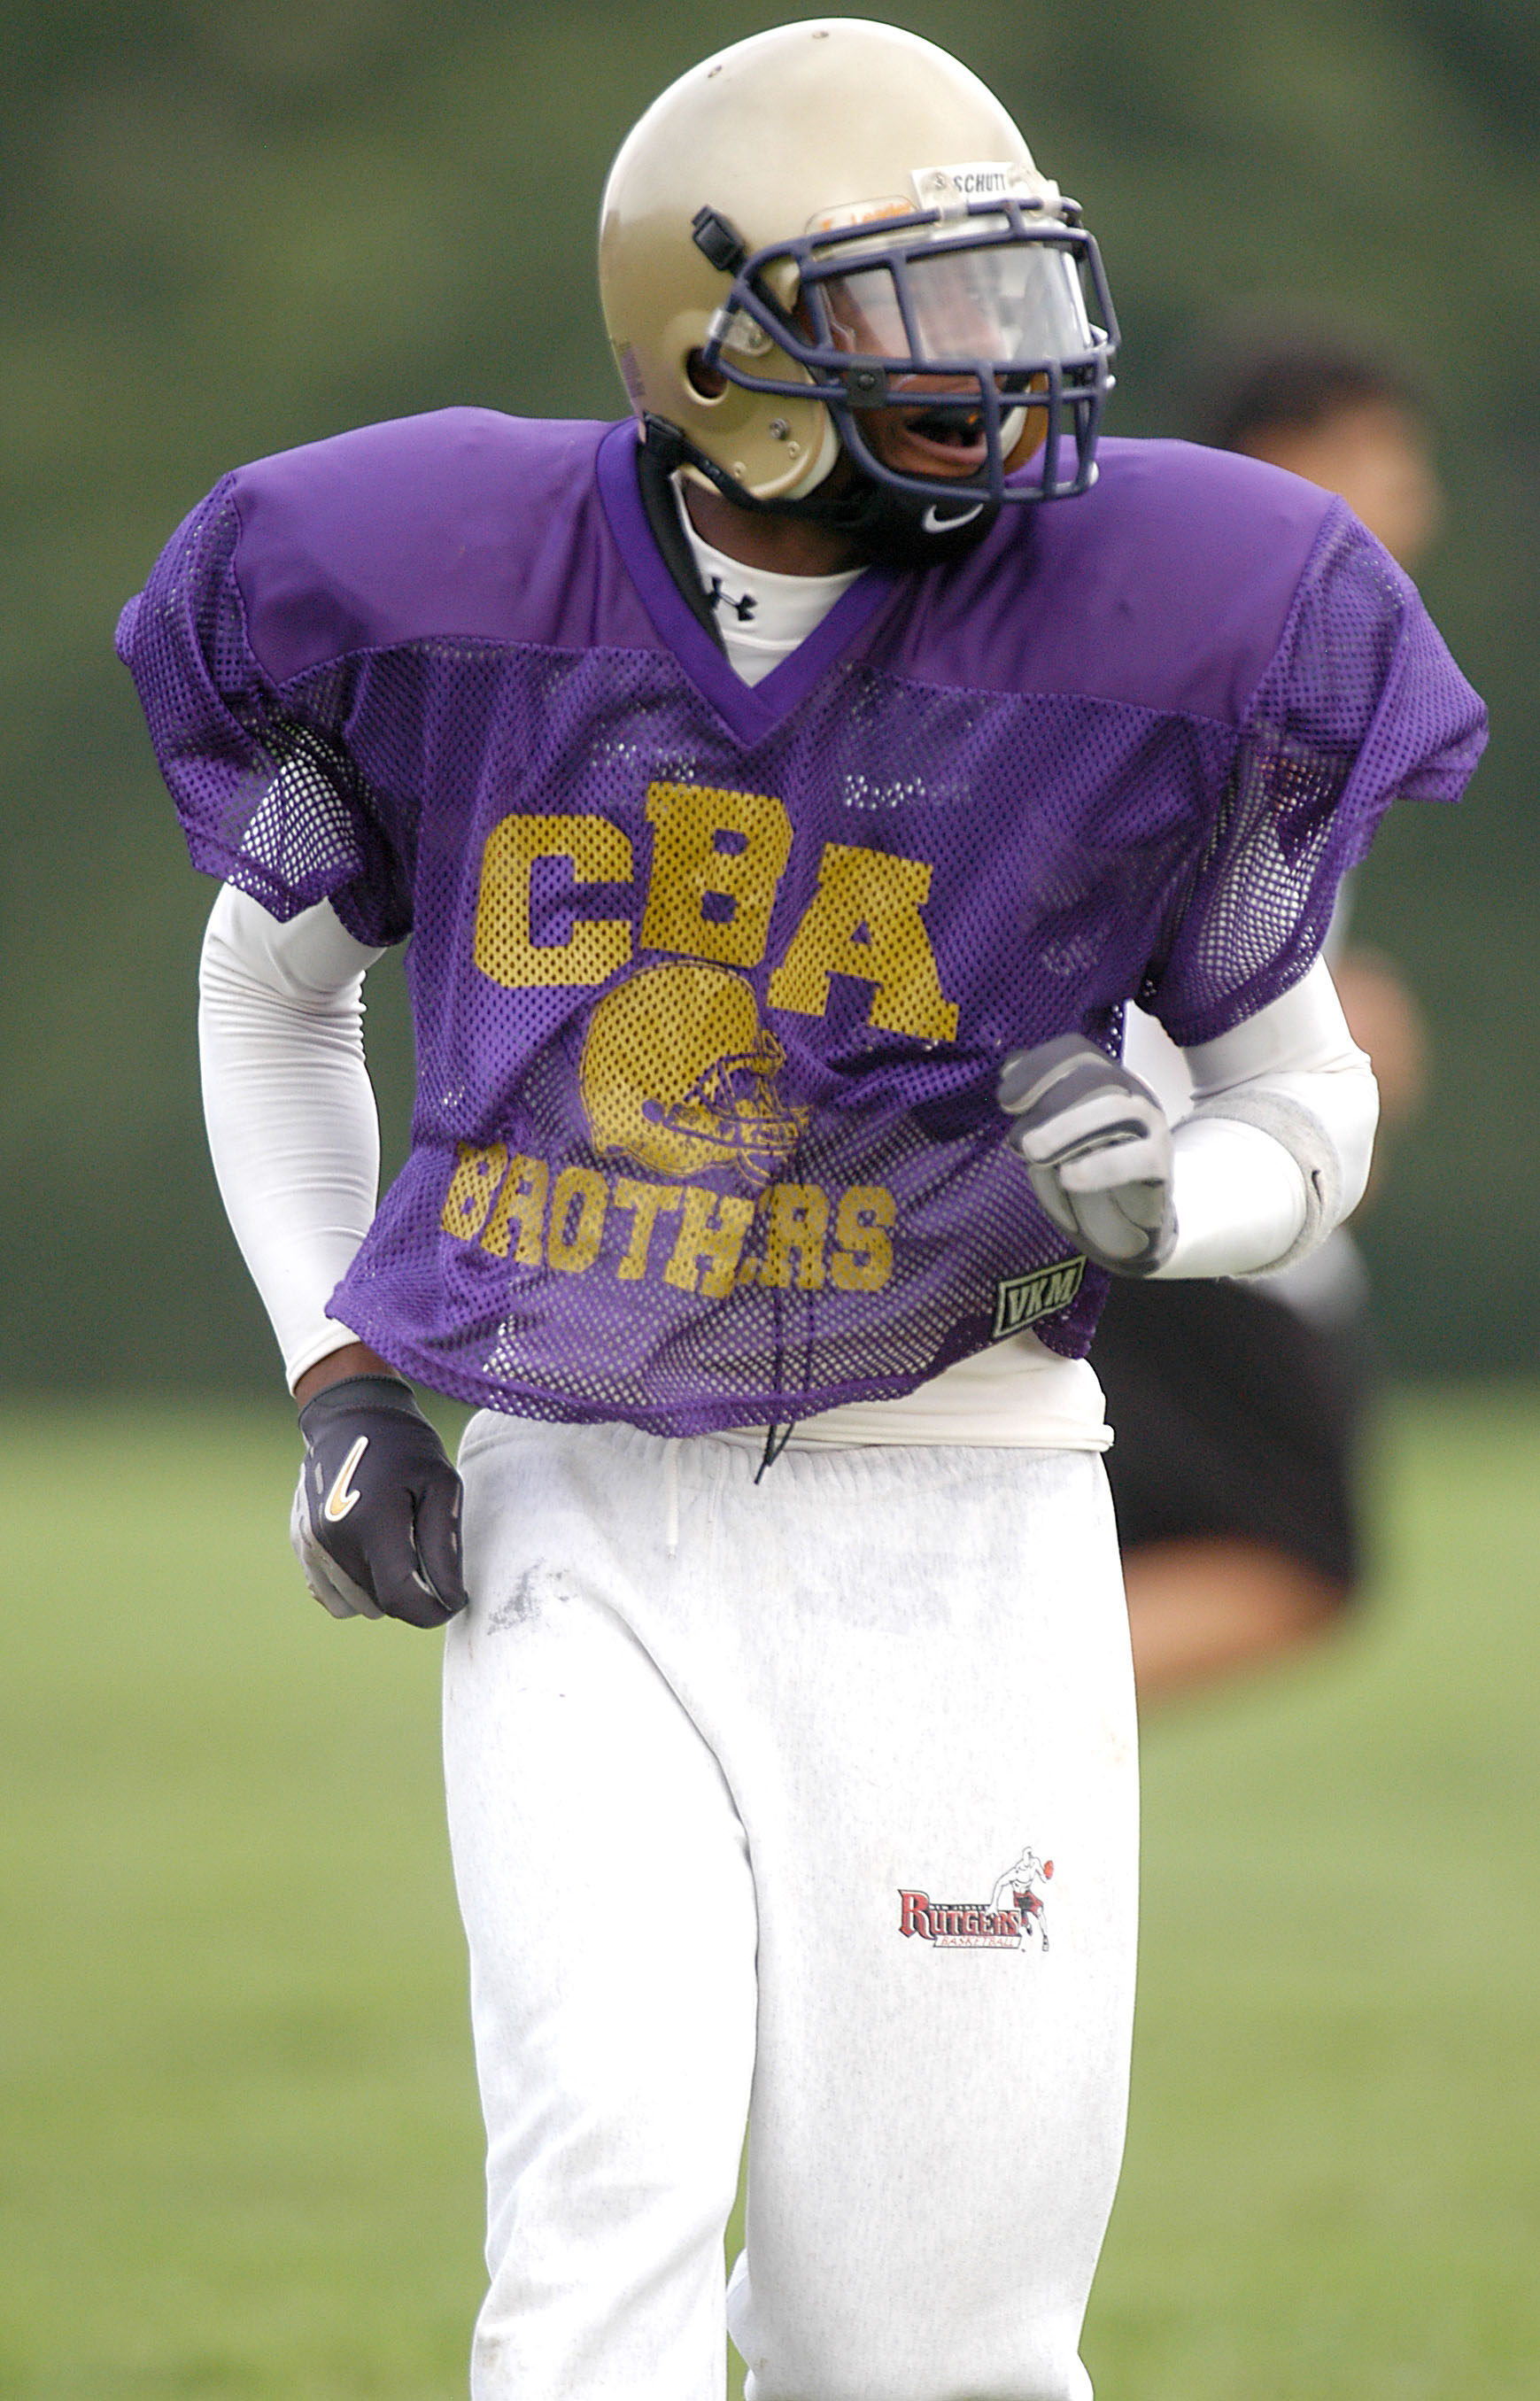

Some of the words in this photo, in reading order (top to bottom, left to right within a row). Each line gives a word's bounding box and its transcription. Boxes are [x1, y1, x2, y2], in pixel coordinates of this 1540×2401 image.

[953, 174, 1006, 193] SCHUTT
[475, 780, 960, 1043] CBA
[441, 1141, 897, 1299] BROTHRS
[1008, 1267, 1078, 1325] VKM
[940, 1935, 1014, 1948] BASKETBALL
